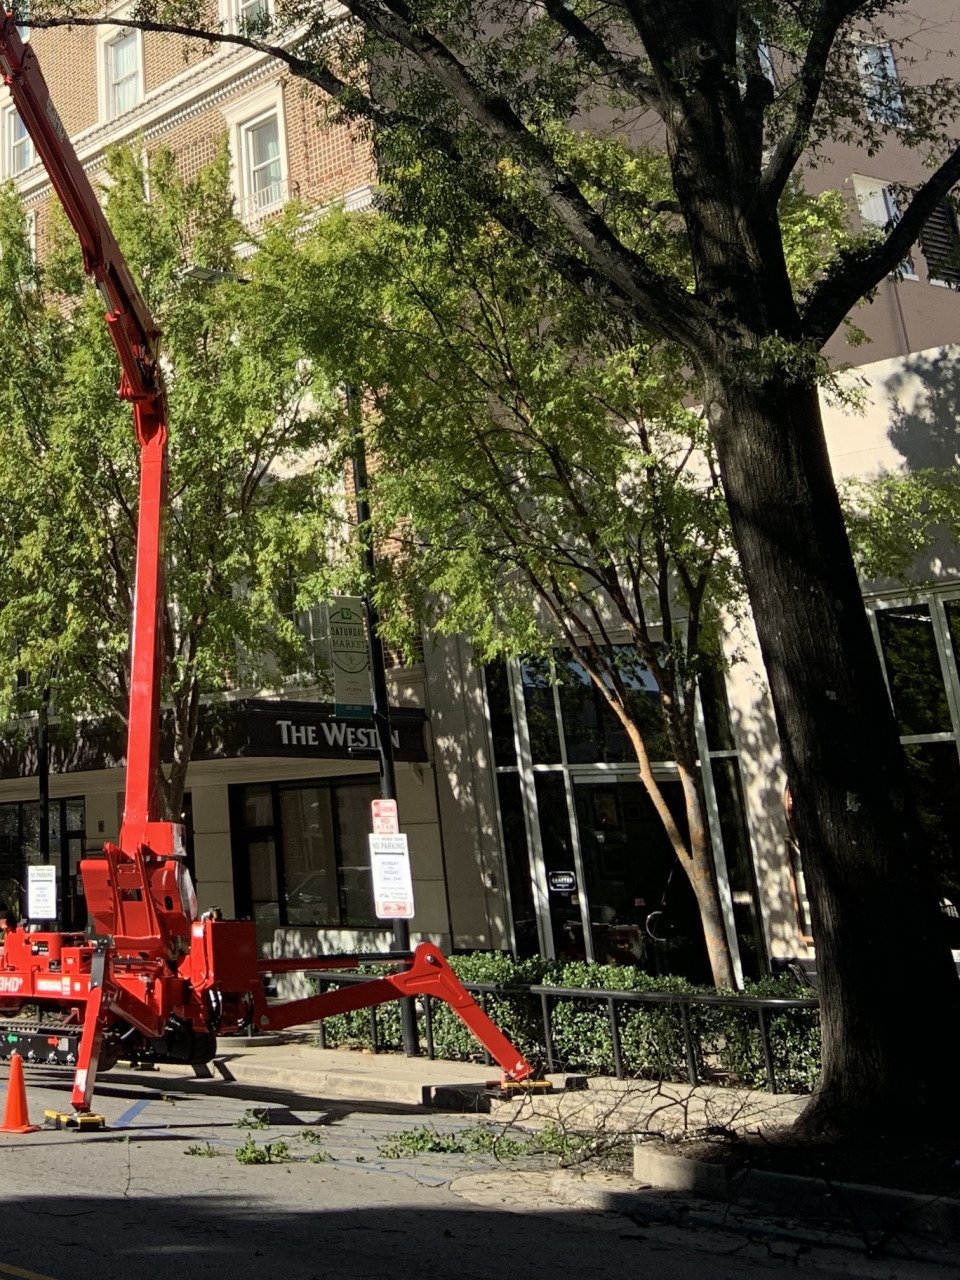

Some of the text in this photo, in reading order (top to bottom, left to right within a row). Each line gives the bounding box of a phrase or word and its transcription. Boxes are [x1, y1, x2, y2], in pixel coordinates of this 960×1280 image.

[332, 639, 367, 649] MARKET
[276, 720, 400, 749] THE WESTN
[381, 842, 406, 850] PARKING
